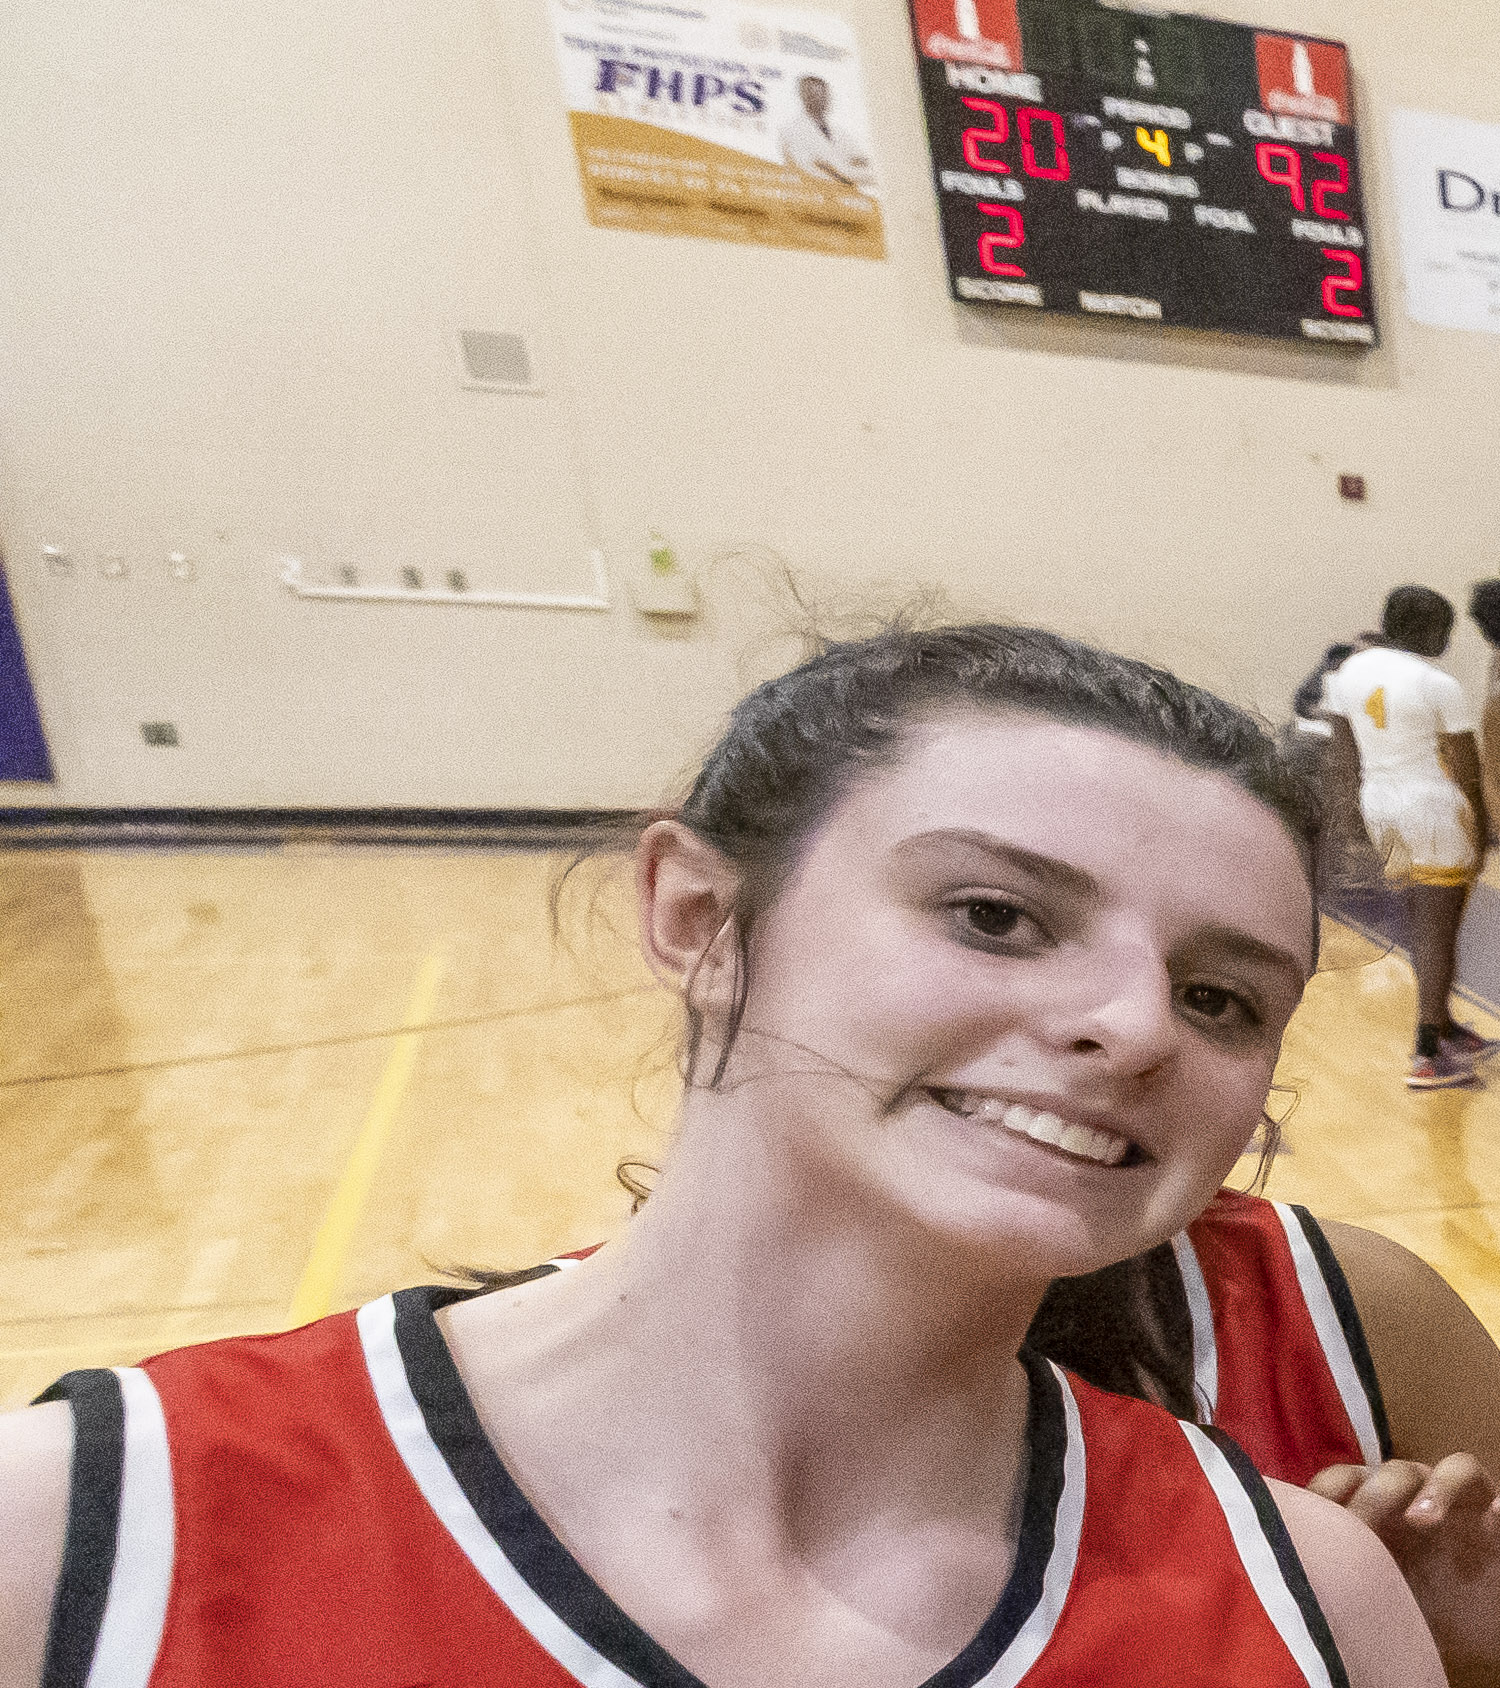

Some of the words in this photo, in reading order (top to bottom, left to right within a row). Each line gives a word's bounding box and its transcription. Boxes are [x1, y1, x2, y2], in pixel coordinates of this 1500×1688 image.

[595, 58, 768, 115] FHPS
[944, 64, 1044, 102] HOME
[1102, 97, 1192, 131] PERIOD
[1242, 109, 1337, 147] GUEST
[961, 97, 1071, 182] 20
[1134, 126, 1172, 168] 4
[1076, 189, 1170, 222] PLAYER
[1255, 141, 1351, 221] 92
[977, 202, 1027, 278] 2
[1321, 248, 1365, 319] 2
